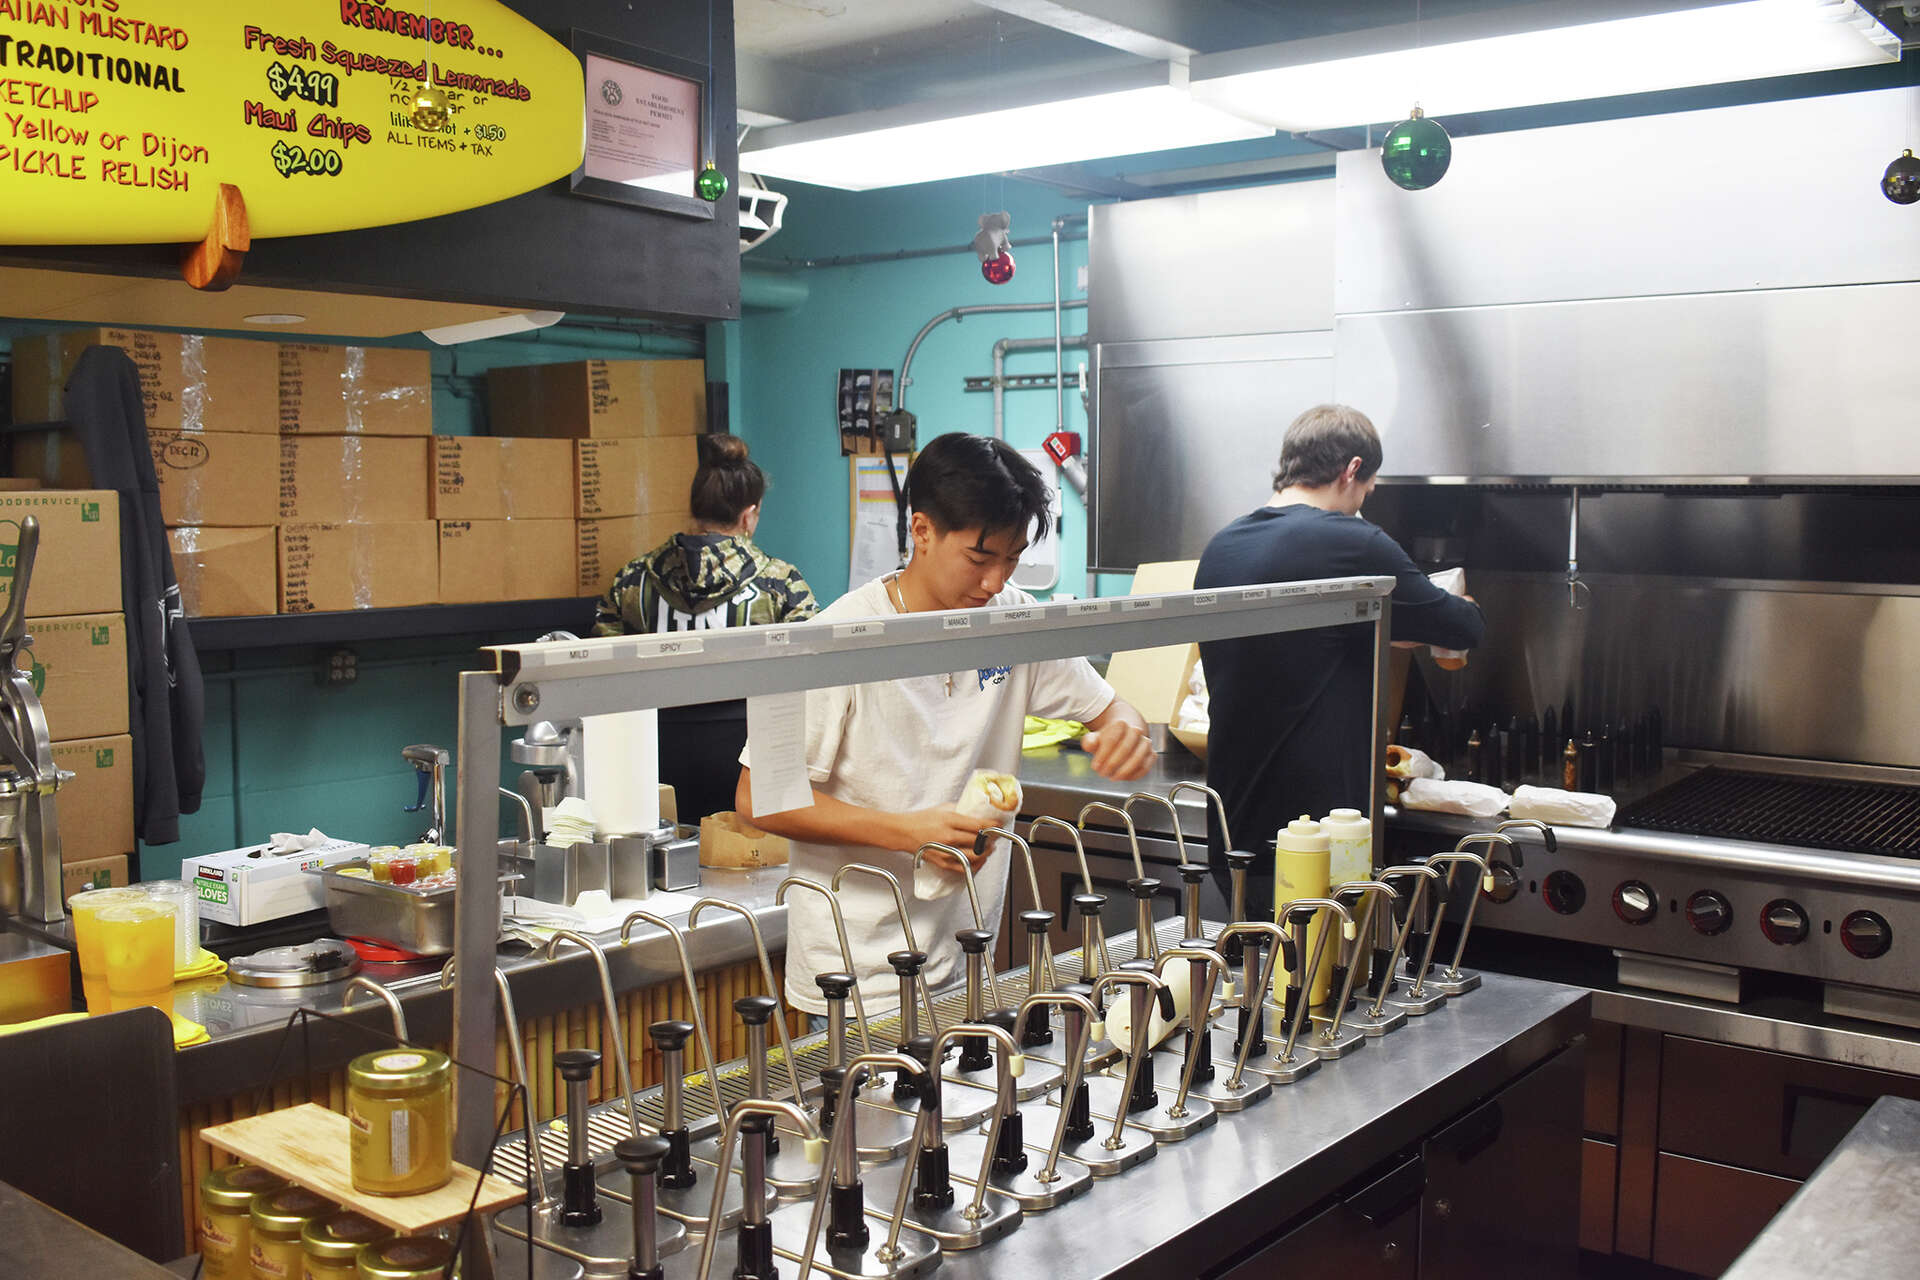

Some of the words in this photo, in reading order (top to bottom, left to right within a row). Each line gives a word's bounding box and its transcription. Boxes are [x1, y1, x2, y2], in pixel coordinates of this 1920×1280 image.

[79, 10, 189, 51] MUSTARD
[0, 34, 185, 93] TRADITIONAL
[244, 25, 317, 61] Fresh
[321, 40, 428, 82] Squeezed
[433, 63, 531, 101] Lemonade
[267, 61, 338, 107] $4.99
[390, 77, 410, 92] 1/2
[473, 95, 488, 105] or
[244, 100, 297, 131] Maui
[307, 114, 371, 148] Chips
[474, 124, 507, 141] $1.50
[5, 112, 89, 147] Yellow
[99, 131, 129, 151] or
[142, 132, 208, 167] Dijon
[386, 131, 413, 146] ALL
[417, 135, 457, 153] ITEMS
[471, 143, 493, 157] TAX
[272, 140, 342, 178] $2.00
[101, 159, 189, 192] RELISH
[1005, 611, 1032, 620] PINEAPPLE
[1080, 604, 1098, 612] PAPAYA
[1134, 601, 1151, 609] BANANA
[851, 625, 867, 634] LAVA
[948, 618, 968, 626] MANGO
[771, 633, 785, 641] HOT
[569, 651, 589, 659] MILD
[660, 643, 681, 653] SPICY
[197, 887, 228, 902] LOVES
